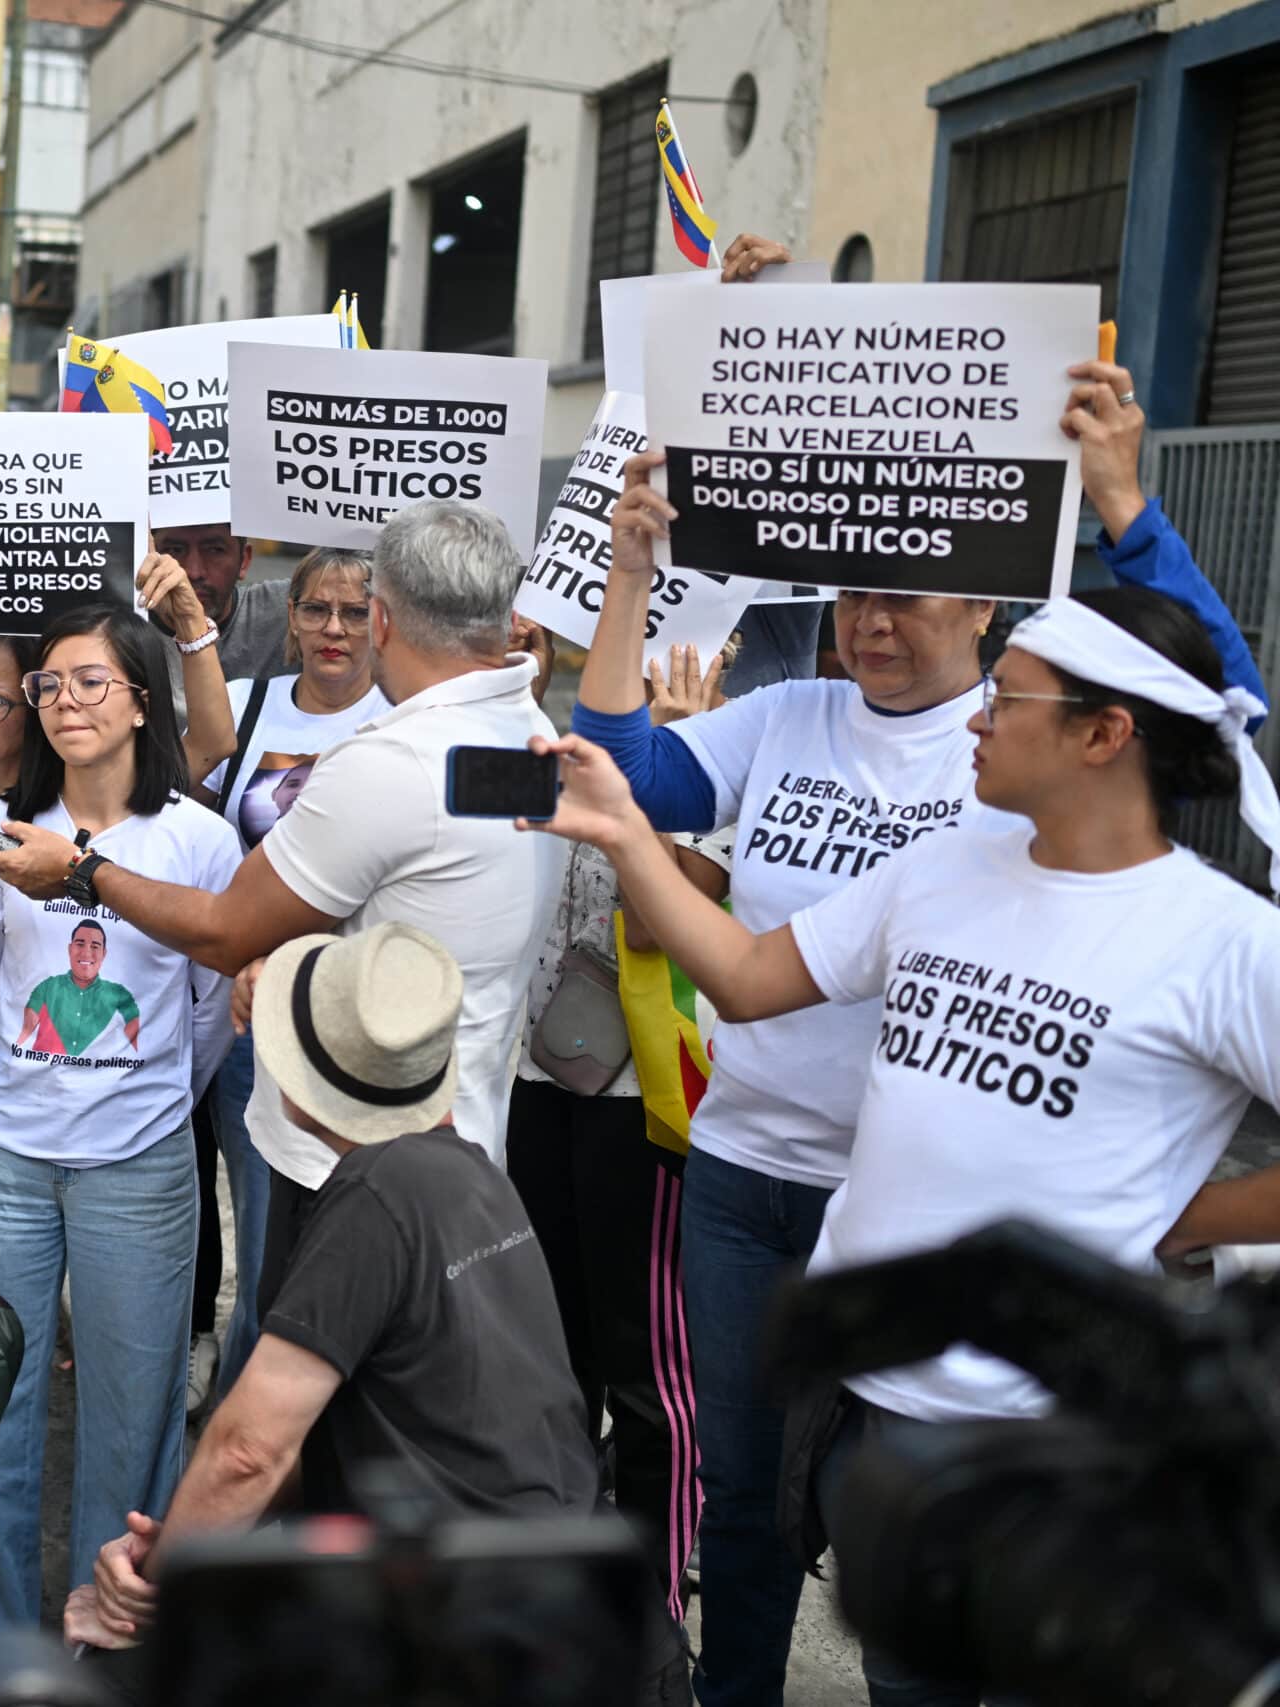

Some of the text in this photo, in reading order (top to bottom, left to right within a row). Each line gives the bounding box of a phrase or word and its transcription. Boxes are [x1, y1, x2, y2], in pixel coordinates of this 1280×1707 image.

[720, 321, 1006, 351] NO HAY NÚMERO
[712, 360, 1009, 386] SIGNIFICATIVO DE
[270, 397, 503, 428] SON MÁS DE 1.000
[702, 393, 1019, 420] EXCARCELACIONES
[274, 430, 487, 465] LOS PRESOS
[729, 427, 975, 453] EN VENEZUELA
[32, 453, 82, 472] QUE
[588, 451, 617, 474] DE
[691, 455, 1025, 490] PERO SÍ UN NÚMERO
[25, 478, 63, 494] SIN
[276, 461, 482, 500] POLÍTICOS
[16, 503, 43, 519] ES
[51, 502, 102, 519] UNA
[287, 496, 400, 524] EN VENE
[693, 486, 1028, 523] DOLOROSO DE PRESOS
[757, 519, 952, 557] POLÍTICOS
[64, 550, 106, 566] LAS
[14, 574, 102, 590] PRESOS
[778, 772, 963, 822] LIBEREN A TODOS
[761, 795, 959, 850] LOS PRES
[897, 950, 1111, 1029] LIBEREN A TODOS
[885, 978, 1094, 1069] LOS PRESOS
[25, 1050, 49, 1062] mas
[50, 1054, 92, 1067] presos
[877, 1020, 1079, 1119] POLÍTICOS
